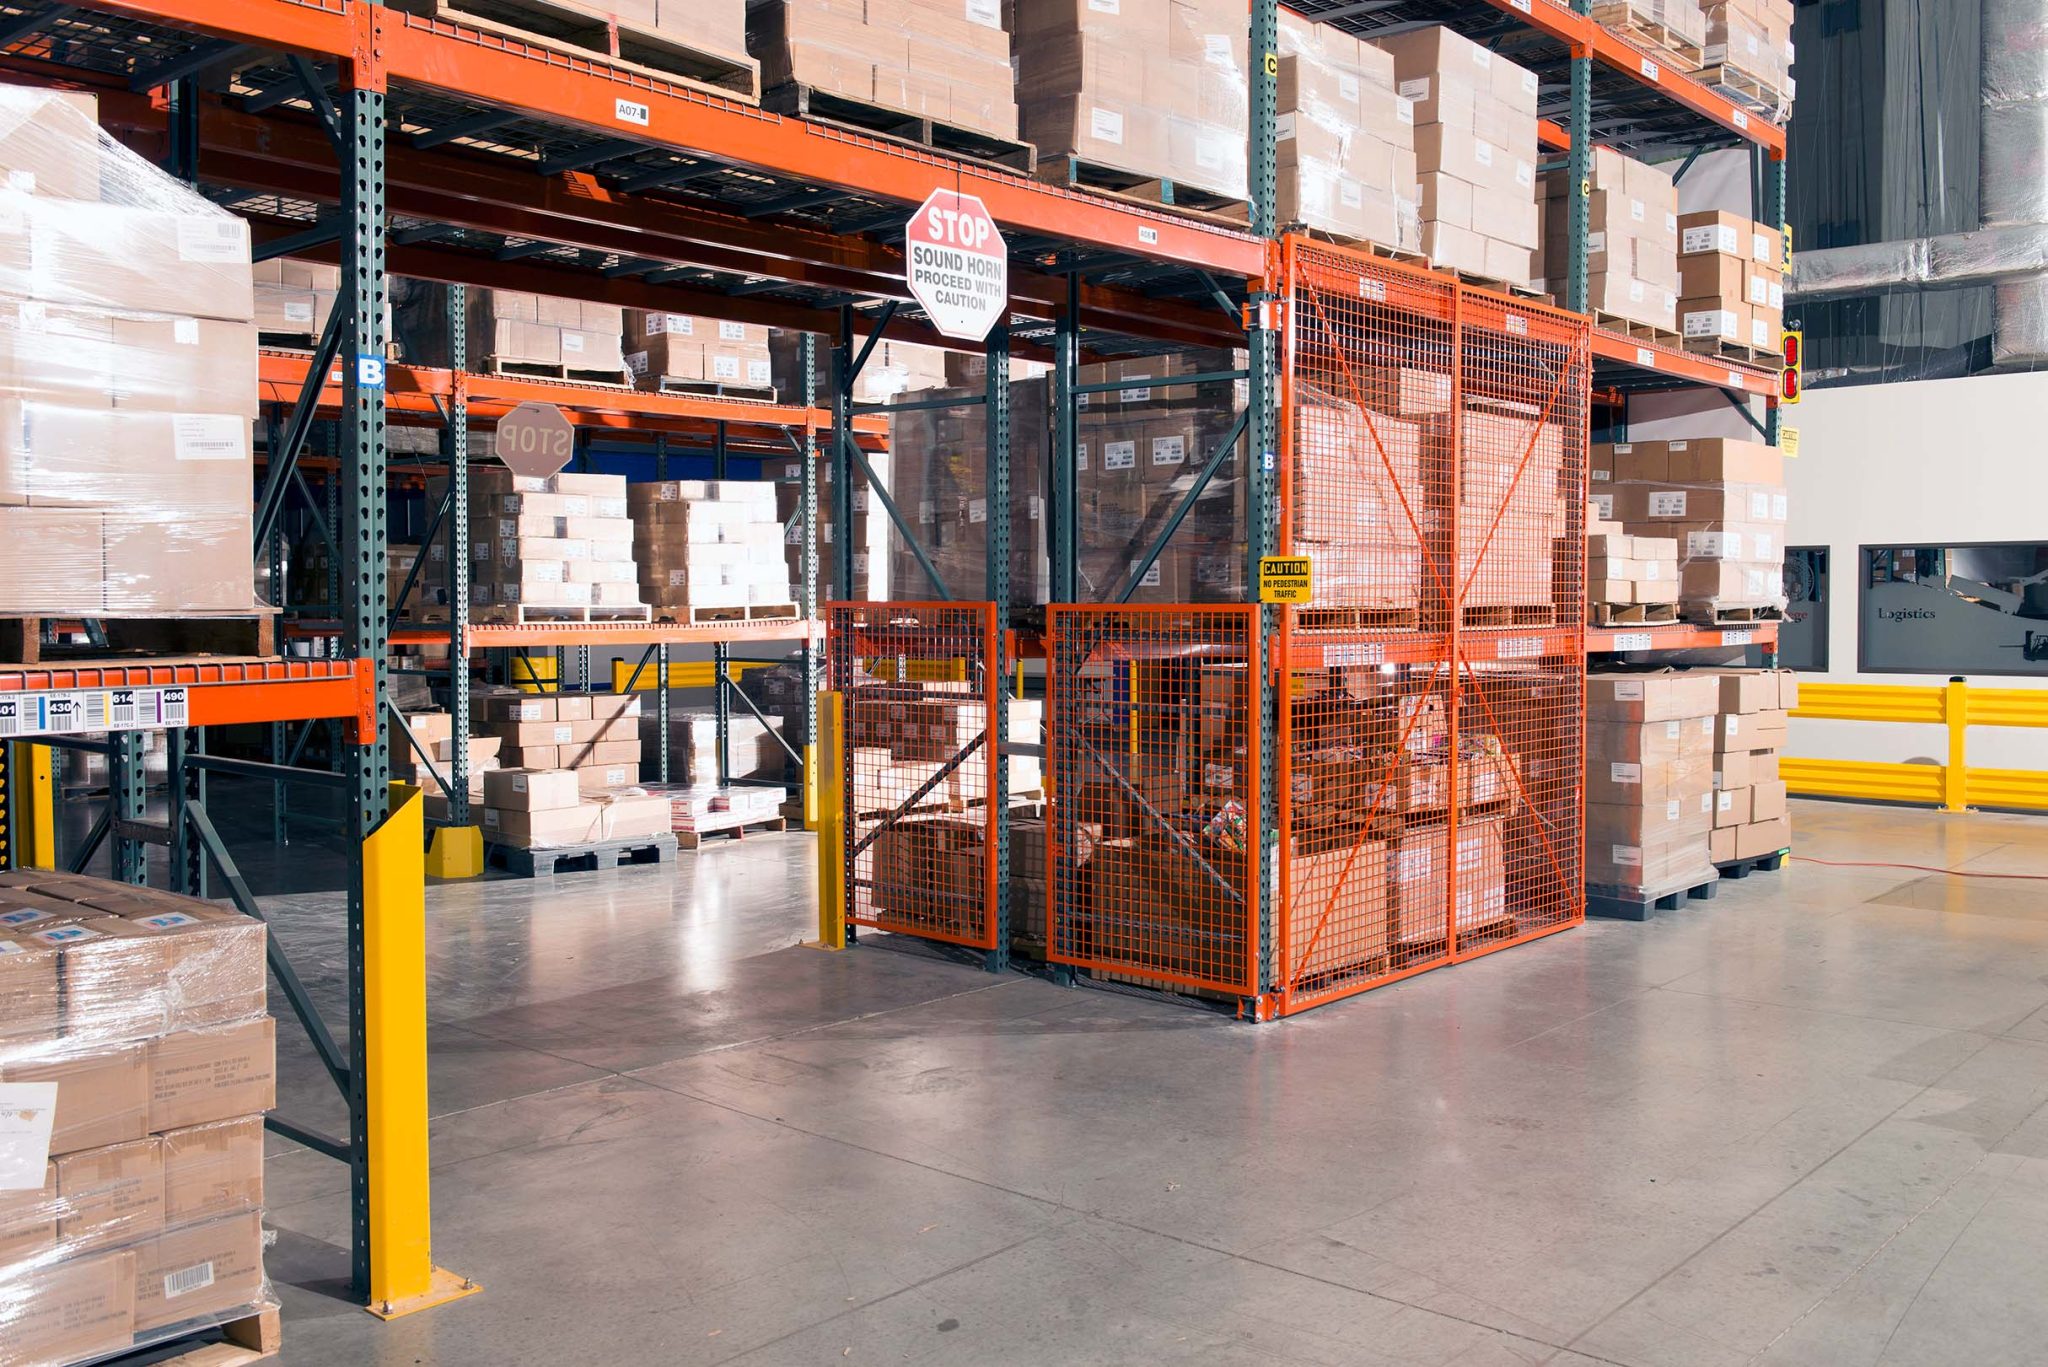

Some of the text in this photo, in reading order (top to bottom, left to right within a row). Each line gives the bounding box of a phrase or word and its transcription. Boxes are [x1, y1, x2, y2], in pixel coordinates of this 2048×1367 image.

[1268, 57, 1276, 73] C
[619, 104, 646, 120] A07-
[928, 206, 989, 248] STOP
[914, 246, 1002, 281] SOUND HORN
[915, 269, 1001, 298] PROCEED WITH
[935, 290, 986, 311] CAUTION
[359, 358, 383, 385] B
[1264, 453, 1274, 470] B
[1264, 563, 1307, 574] CAUTION
[1274, 590, 1296, 598] TRAFFIC
[1878, 607, 1936, 623] Logistics
[113, 693, 133, 703] 614
[164, 691, 184, 702] 490
[0, 704, 15, 715] 01
[50, 702, 71, 713] 430
